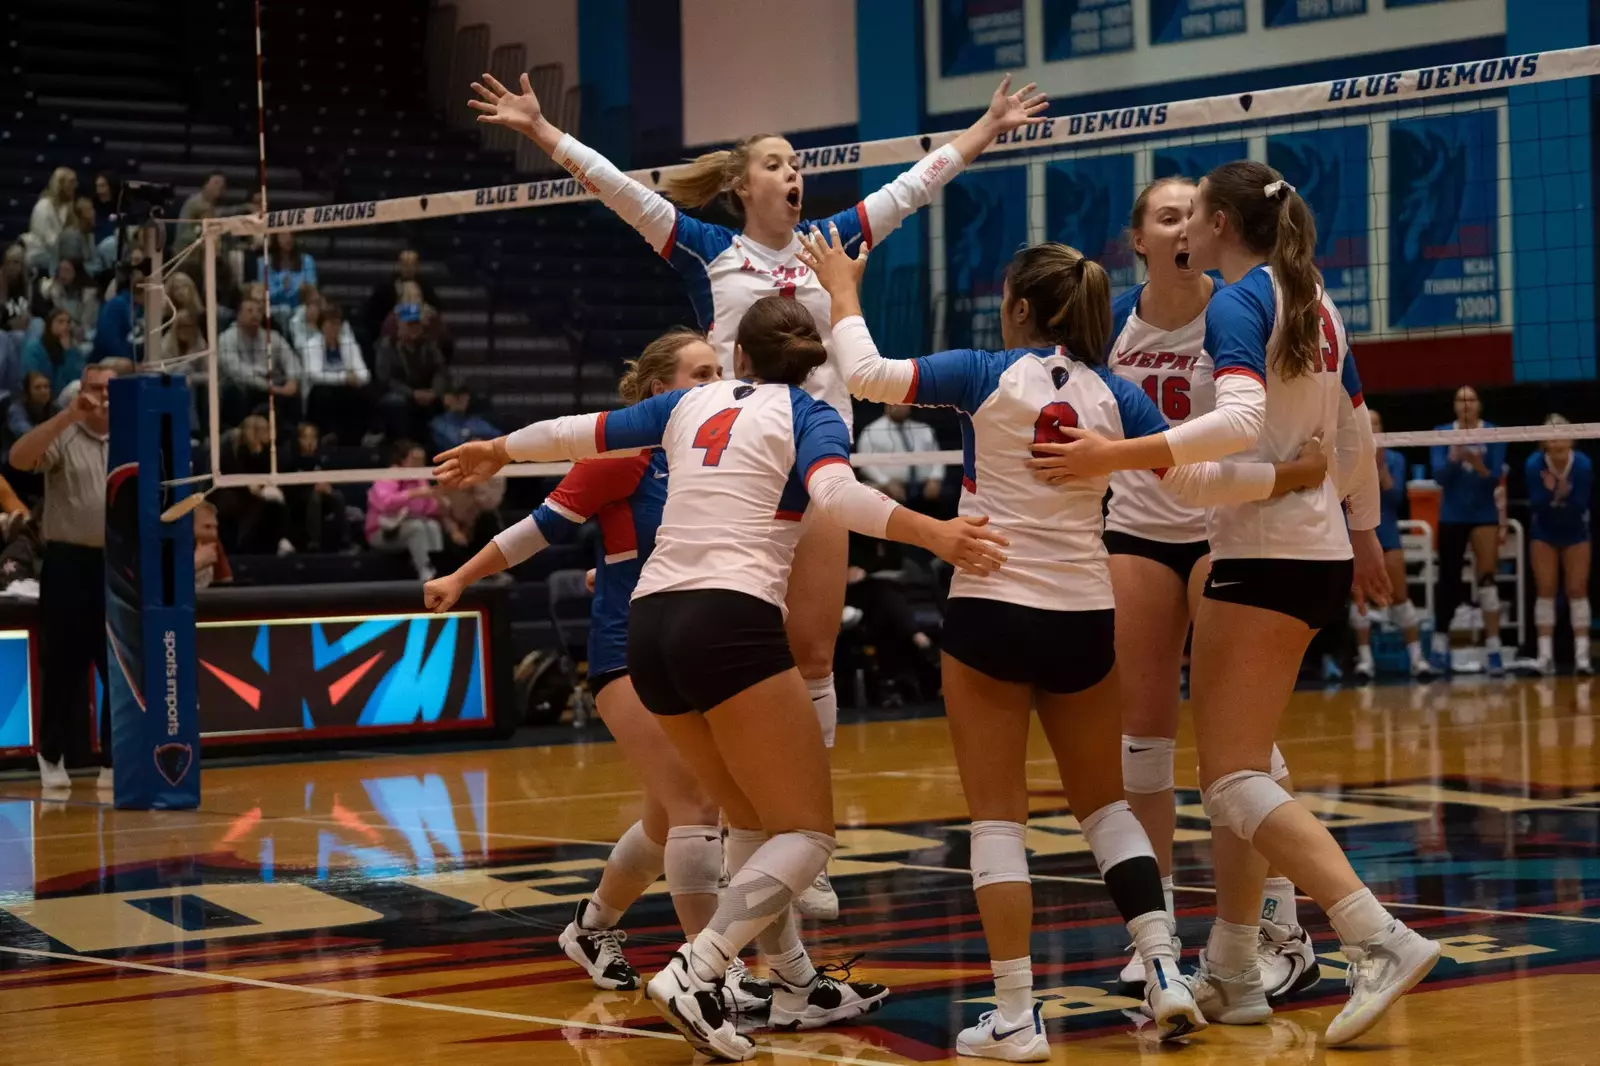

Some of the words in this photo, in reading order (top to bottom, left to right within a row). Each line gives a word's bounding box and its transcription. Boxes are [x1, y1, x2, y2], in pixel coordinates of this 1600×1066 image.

[1327, 73, 1402, 102] BLUE
[1416, 54, 1539, 92] DEMONS
[995, 120, 1055, 145] BLUE
[1067, 105, 1168, 136] DEMONS
[796, 143, 861, 169] MONS
[475, 184, 519, 206] BLUE
[527, 178, 588, 200] DEMON
[267, 209, 305, 228] BLUE
[313, 202, 377, 224] DEMONS
[1118, 350, 1200, 371] DEPA
[1141, 374, 1191, 421] 16
[692, 407, 744, 467] 4
[163, 630, 178, 678] sports
[164, 678, 180, 736] imports
